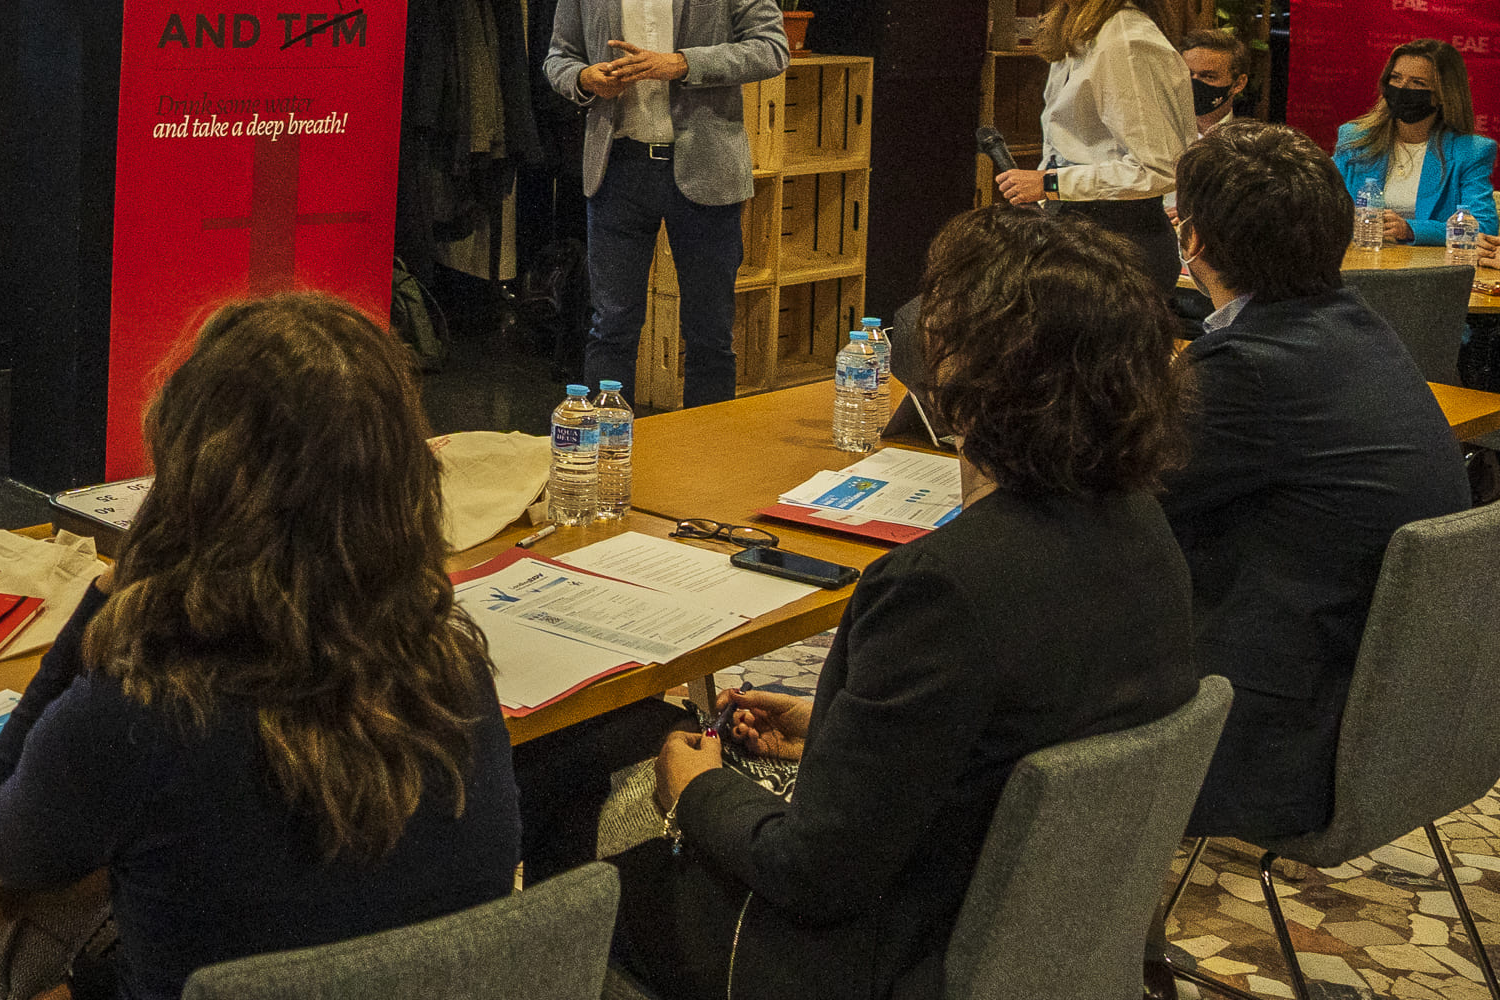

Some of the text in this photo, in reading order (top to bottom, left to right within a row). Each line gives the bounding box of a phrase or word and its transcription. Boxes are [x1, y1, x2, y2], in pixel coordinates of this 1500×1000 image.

[156, 12, 368, 49] AND TFM
[156, 92, 313, 116] Drink some water
[153, 111, 349, 142] and take a deep breath!
[96, 494, 118, 502] 35
[94, 507, 116, 515] 40
